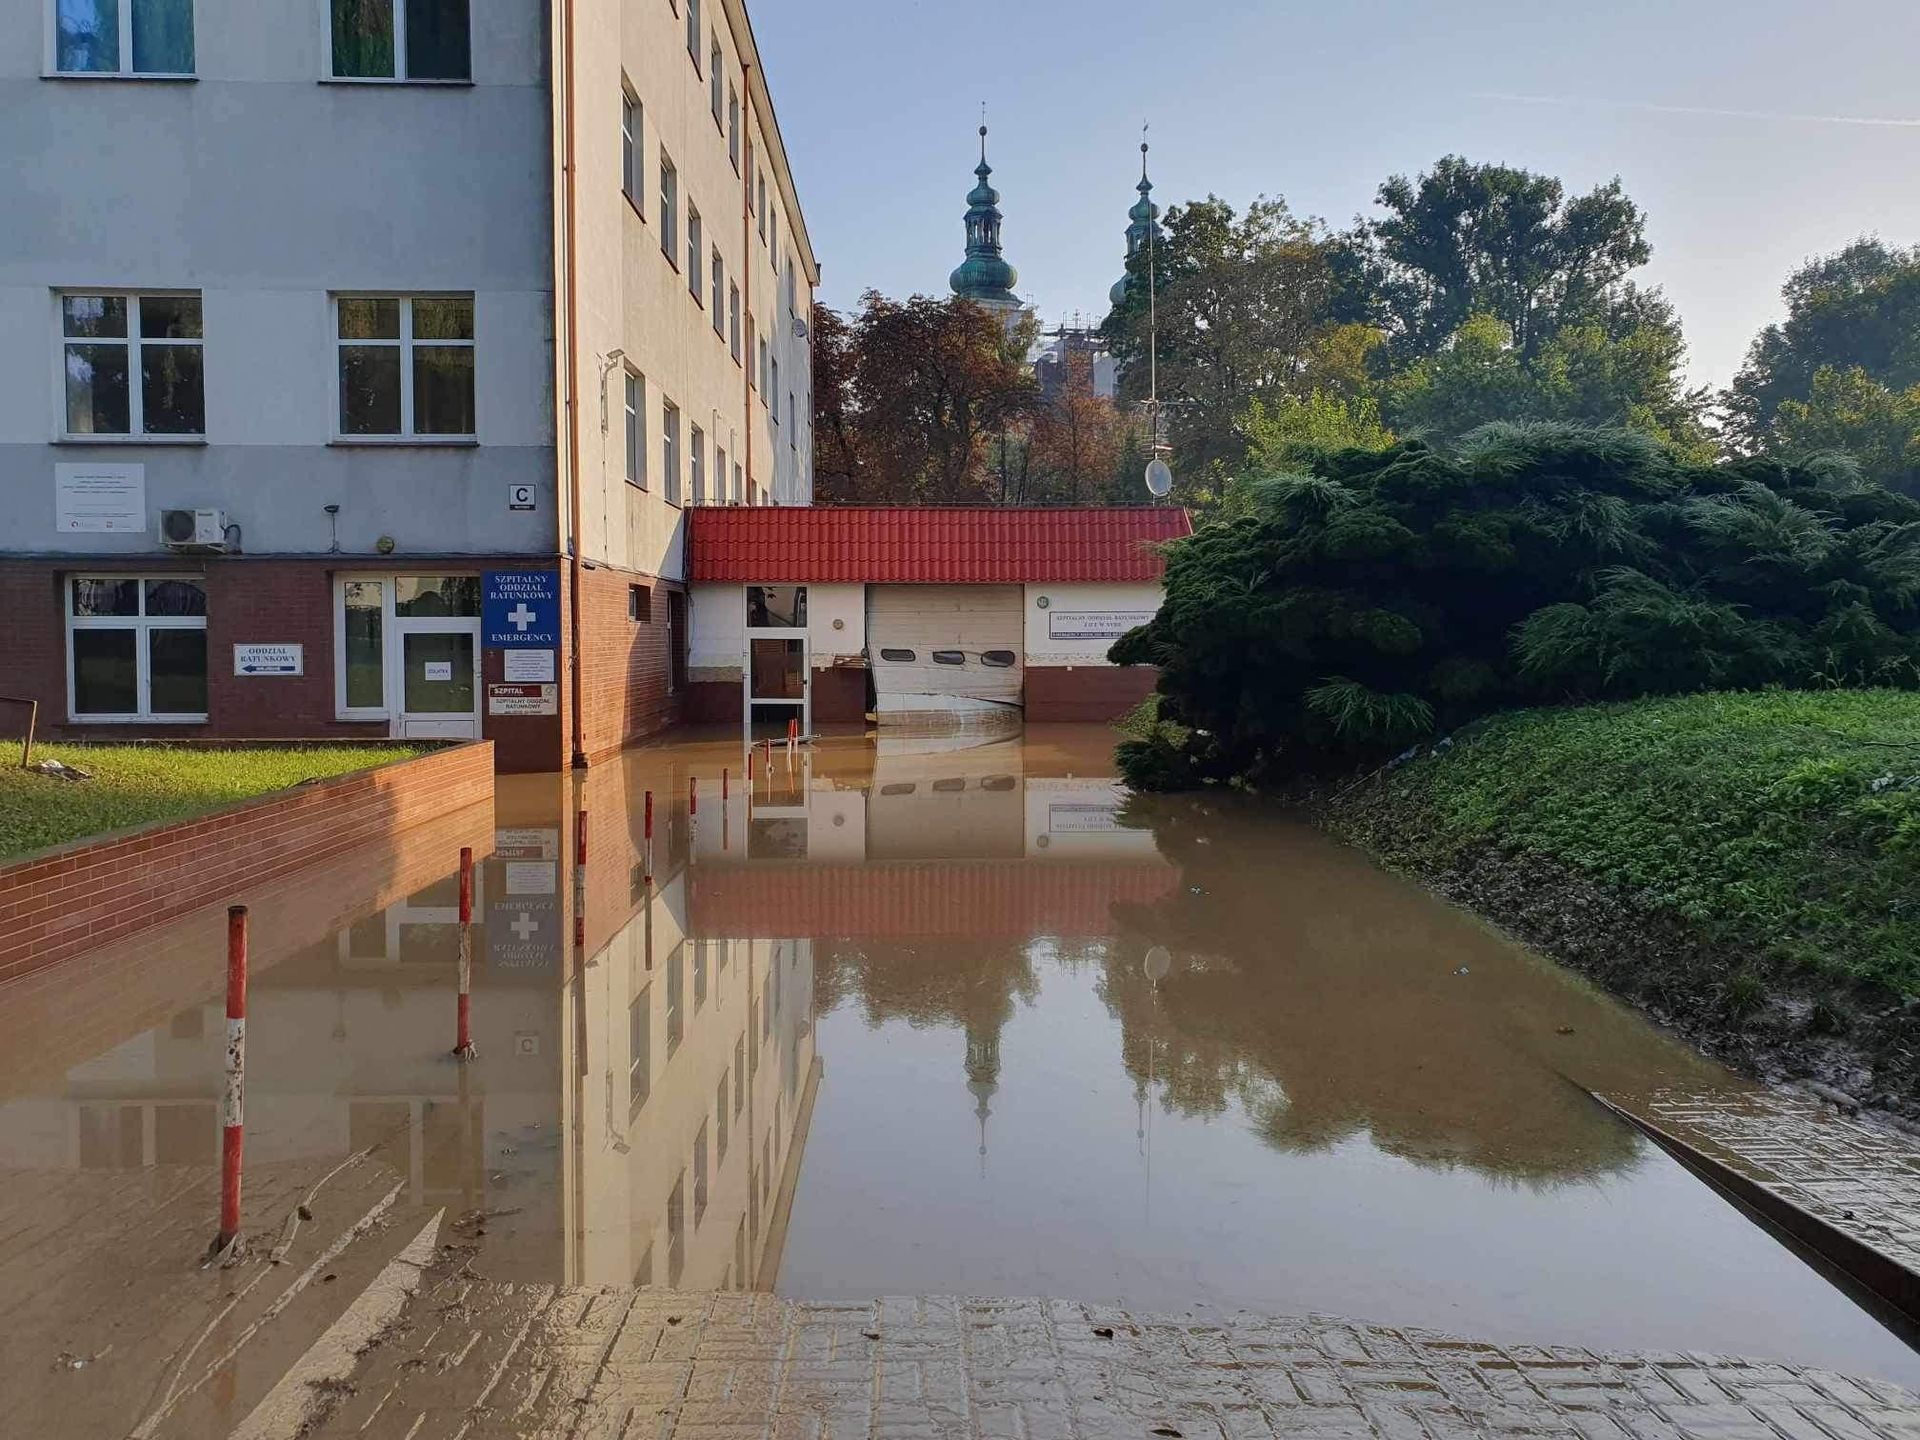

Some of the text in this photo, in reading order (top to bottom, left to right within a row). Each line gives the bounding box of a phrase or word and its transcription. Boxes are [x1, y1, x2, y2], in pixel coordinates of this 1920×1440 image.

[516, 487, 529, 503] C
[494, 575, 548, 583] SZPITALNY
[490, 591, 553, 600] RATUNKOWY
[491, 632, 553, 641] EMERGENCY
[494, 686, 524, 695] SZPITAL
